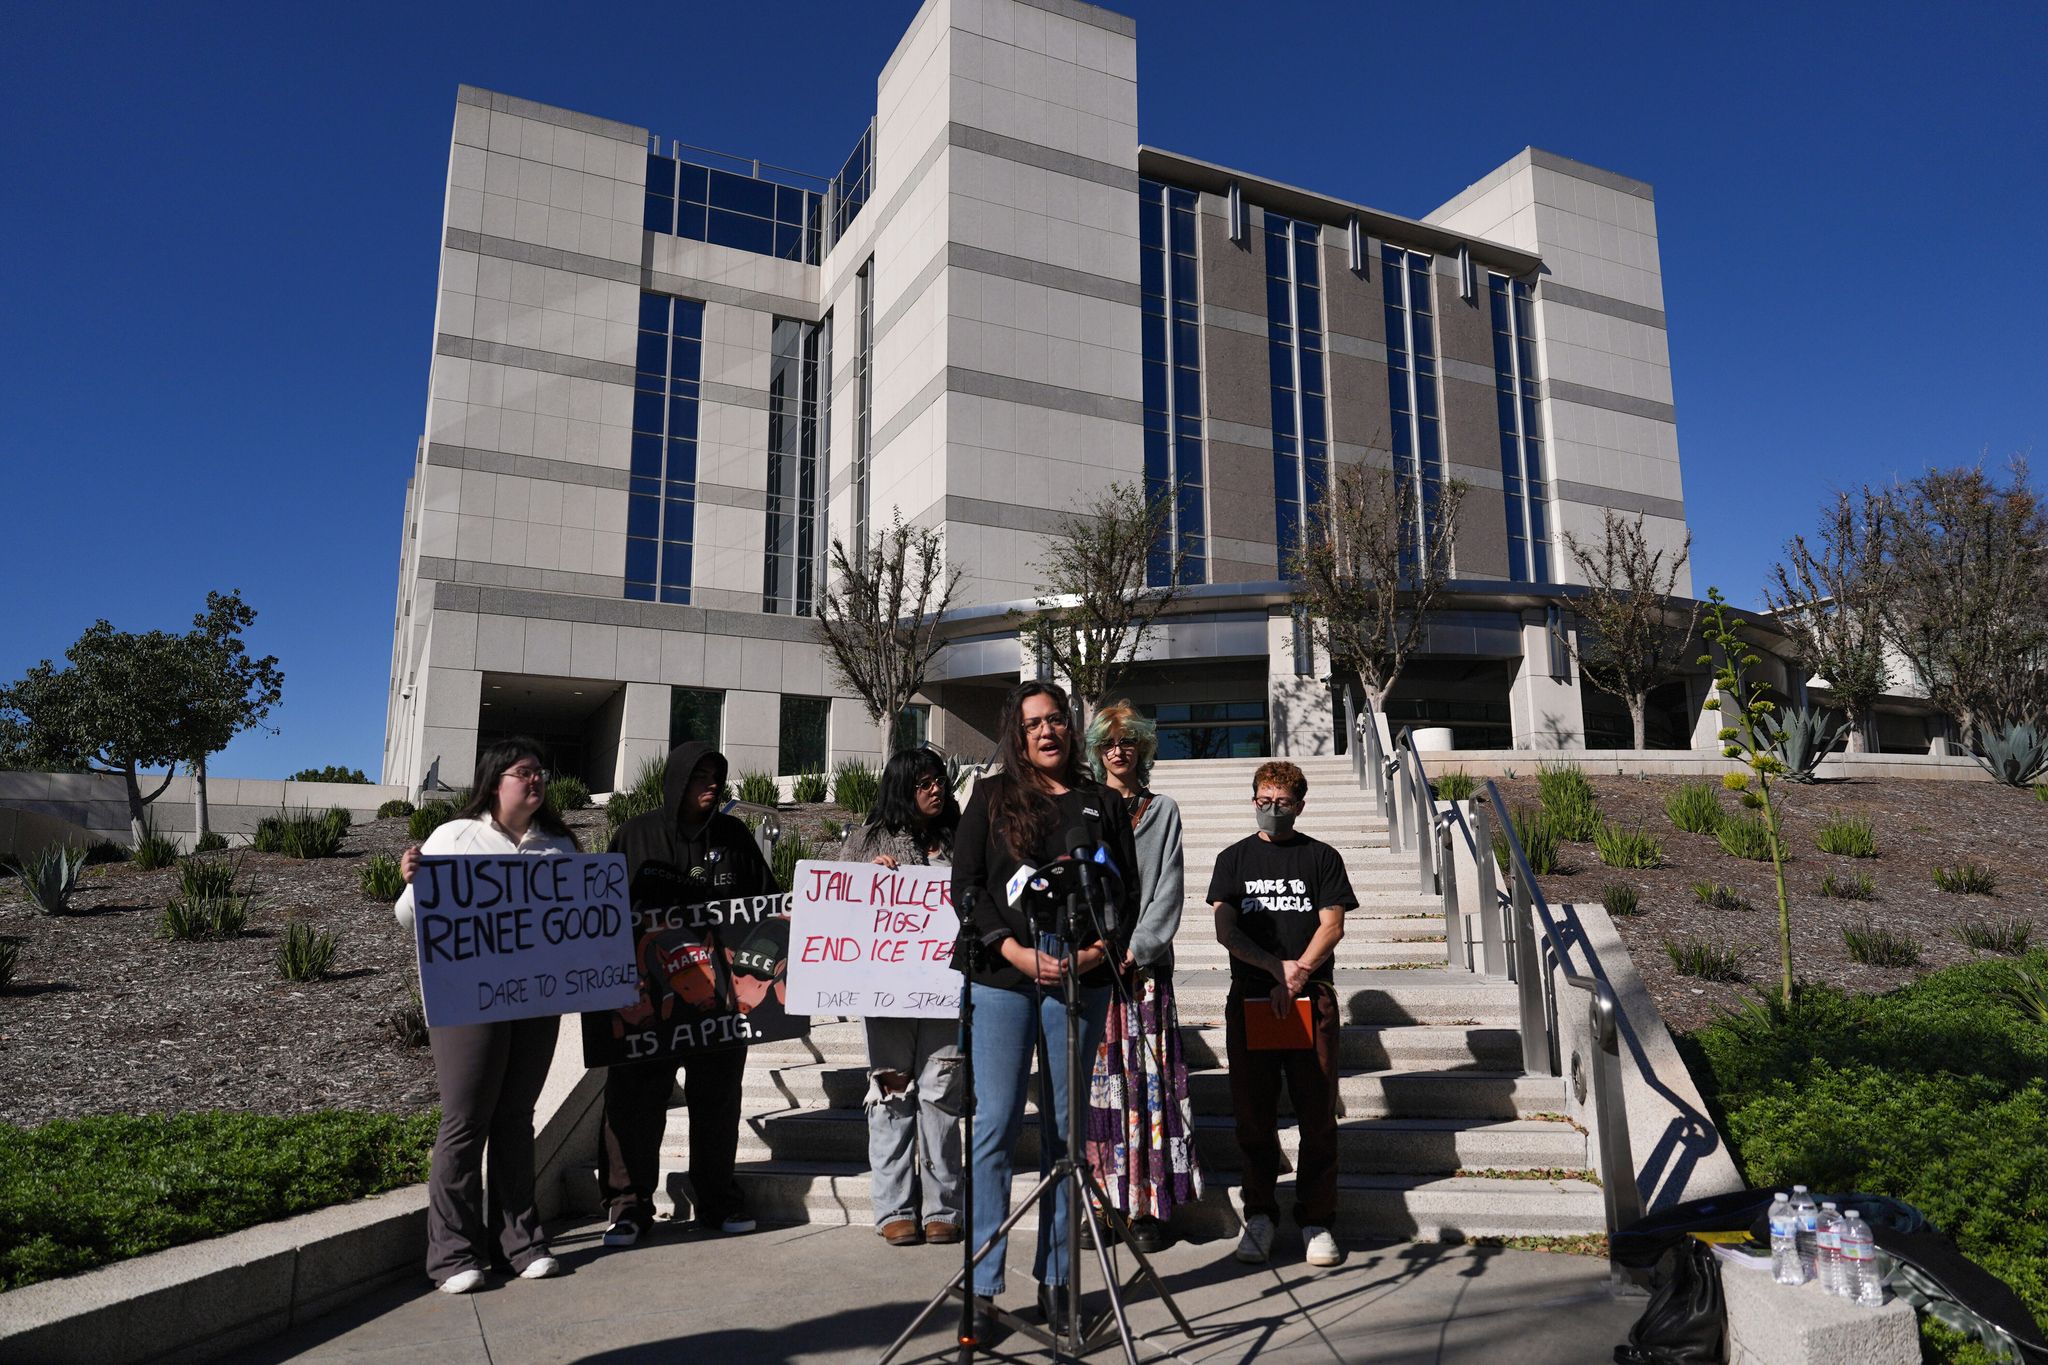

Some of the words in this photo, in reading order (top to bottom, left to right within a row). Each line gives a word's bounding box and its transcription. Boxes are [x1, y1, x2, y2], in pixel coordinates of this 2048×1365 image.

[419, 858, 574, 909] JUSTICE
[584, 862, 624, 900] FOR
[806, 869, 862, 903] JAIL
[1245, 879, 1287, 895] DARE
[1288, 879, 1306, 895] TO
[688, 899, 724, 927] IS
[729, 897, 751, 925] A
[1241, 896, 1313, 914] STRUGGLE
[422, 908, 535, 964] RENEE
[542, 904, 622, 945] GOOD
[873, 909, 931, 934] PIGS!
[667, 950, 708, 973] MAGA
[739, 951, 773, 972] ICE
[801, 936, 861, 963] END
[870, 938, 908, 963] ICE
[479, 978, 529, 1011] DARE
[534, 973, 557, 998] TO
[565, 963, 637, 995] STRUGGLE
[817, 991, 861, 1008] DARE
[874, 991, 895, 1007] TO
[903, 991, 961, 1010] STRUGG
[625, 1031, 659, 1059] IS
[670, 1024, 696, 1051] A
[701, 1014, 763, 1046] PIG.
